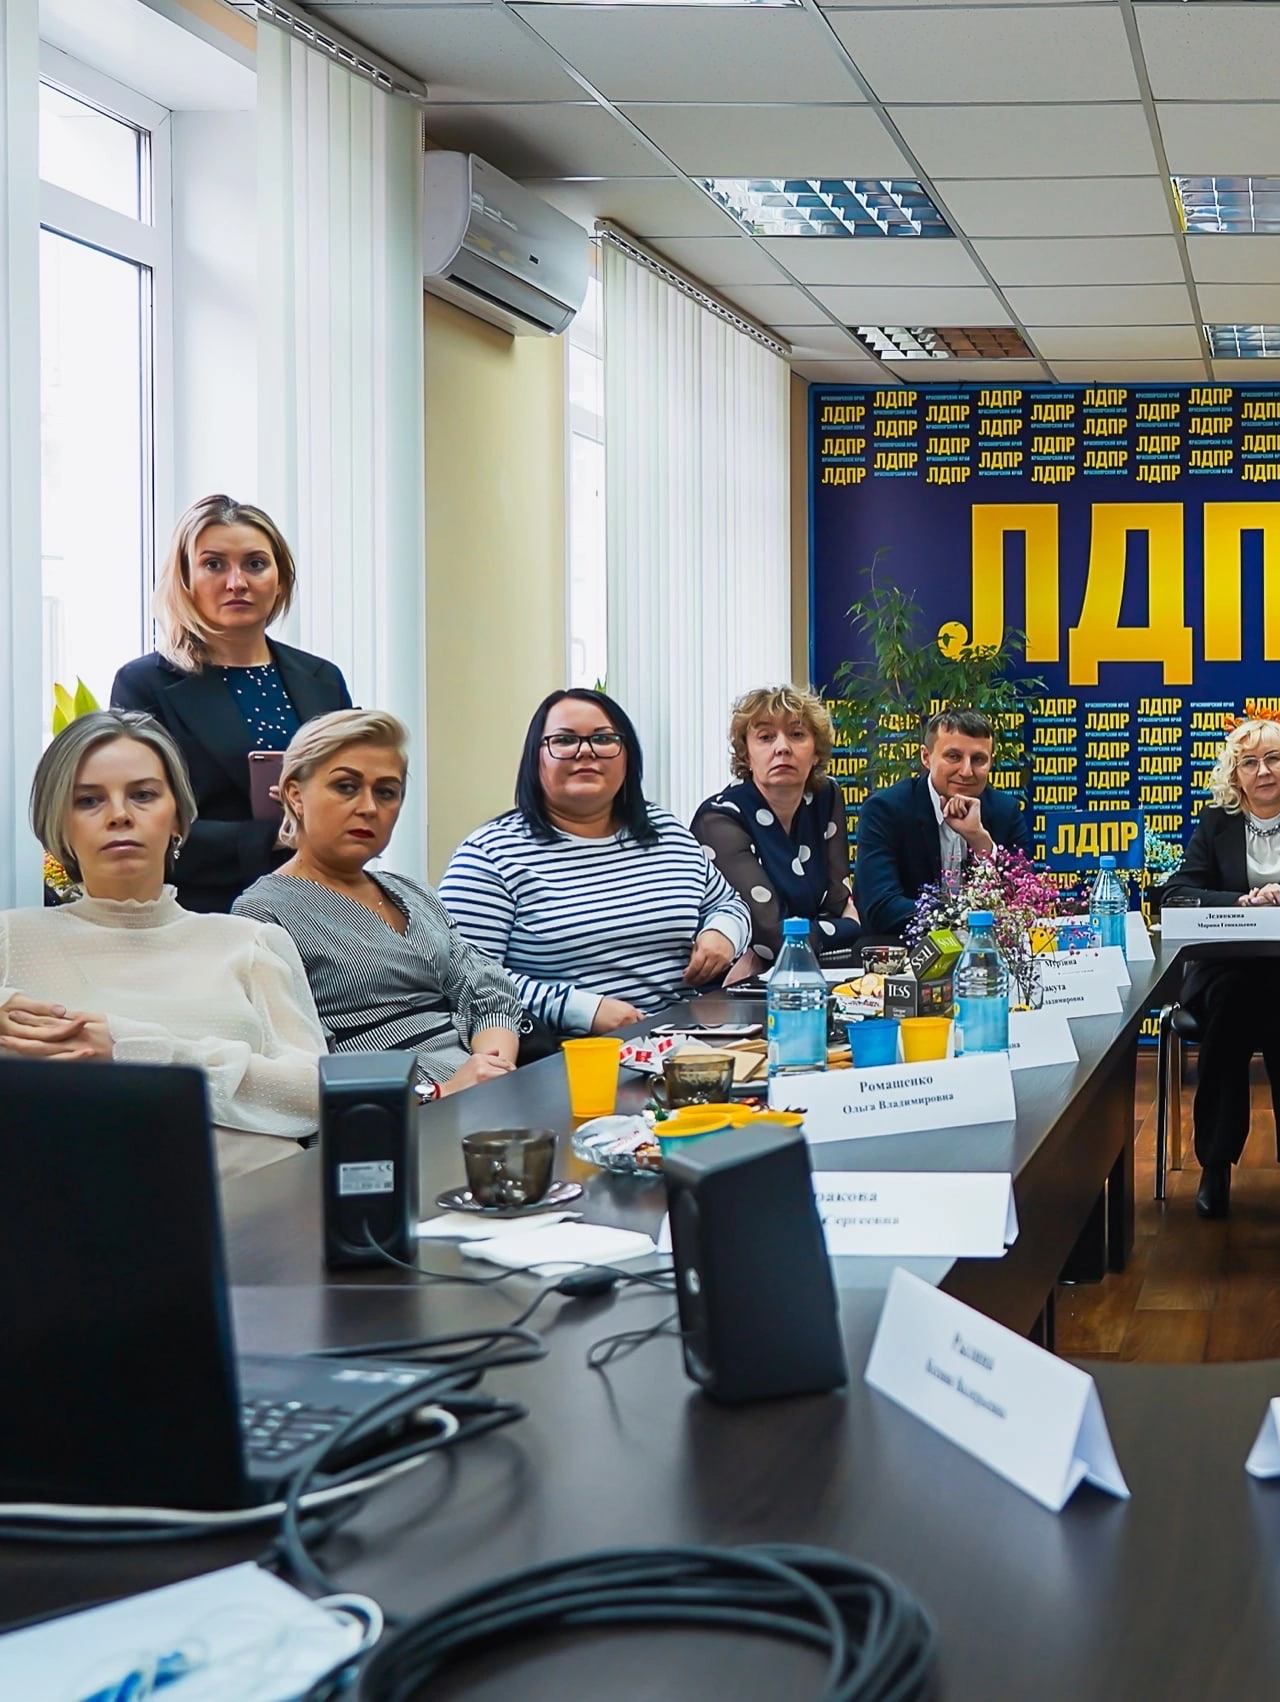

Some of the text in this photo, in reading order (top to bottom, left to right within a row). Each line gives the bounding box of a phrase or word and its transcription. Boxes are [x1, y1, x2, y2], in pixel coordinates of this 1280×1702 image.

[873, 391, 918, 409] ЛДПР
[977, 390, 1023, 408] ЛДПР
[1082, 389, 1128, 407] ЛДПР
[1188, 388, 1233, 406] ЛДПР
[820, 406, 866, 424] ЛДПР
[926, 405, 970, 423] ЛДПР
[1030, 404, 1075, 422] ЛДПР
[1135, 403, 1181, 421] ЛДПР
[873, 419, 918, 439] ЛДПР
[978, 419, 1023, 437] ЛДПР
[1082, 418, 1128, 436] ЛДПР
[1188, 417, 1233, 436] ЛДПР
[821, 438, 866, 456] ЛДПР
[926, 437, 971, 455] ЛДПР
[1031, 436, 1076, 455] ЛДПР
[1135, 435, 1181, 454] ЛДПР
[874, 452, 918, 470] ЛДПР
[979, 451, 1023, 470] ЛДПР
[1084, 450, 1128, 469] ЛДПР
[1189, 449, 1234, 468] ЛДПР
[822, 467, 867, 486] ЛДПР
[927, 466, 971, 484] ЛДПР
[1031, 465, 1076, 484] ЛДПР
[1135, 464, 1181, 483] ЛДПР
[1138, 698, 1183, 716] ЛДПР
[1085, 712, 1130, 731] ЛДПР
[1033, 727, 1078, 746] ЛДПР
[1138, 727, 1183, 746] ЛДПР
[1085, 741, 1130, 760] ЛДПР
[1033, 756, 1078, 775] ЛДПР
[1138, 756, 1183, 774] ЛДПР
[1086, 771, 1130, 789] ЛДПР
[1033, 786, 1078, 804] ЛДПР
[1138, 785, 1183, 803] ЛДПР
[1052, 821, 1138, 858] ЛДПР
[910, 945, 934, 970] TESS
[887, 983, 911, 999] TESS
